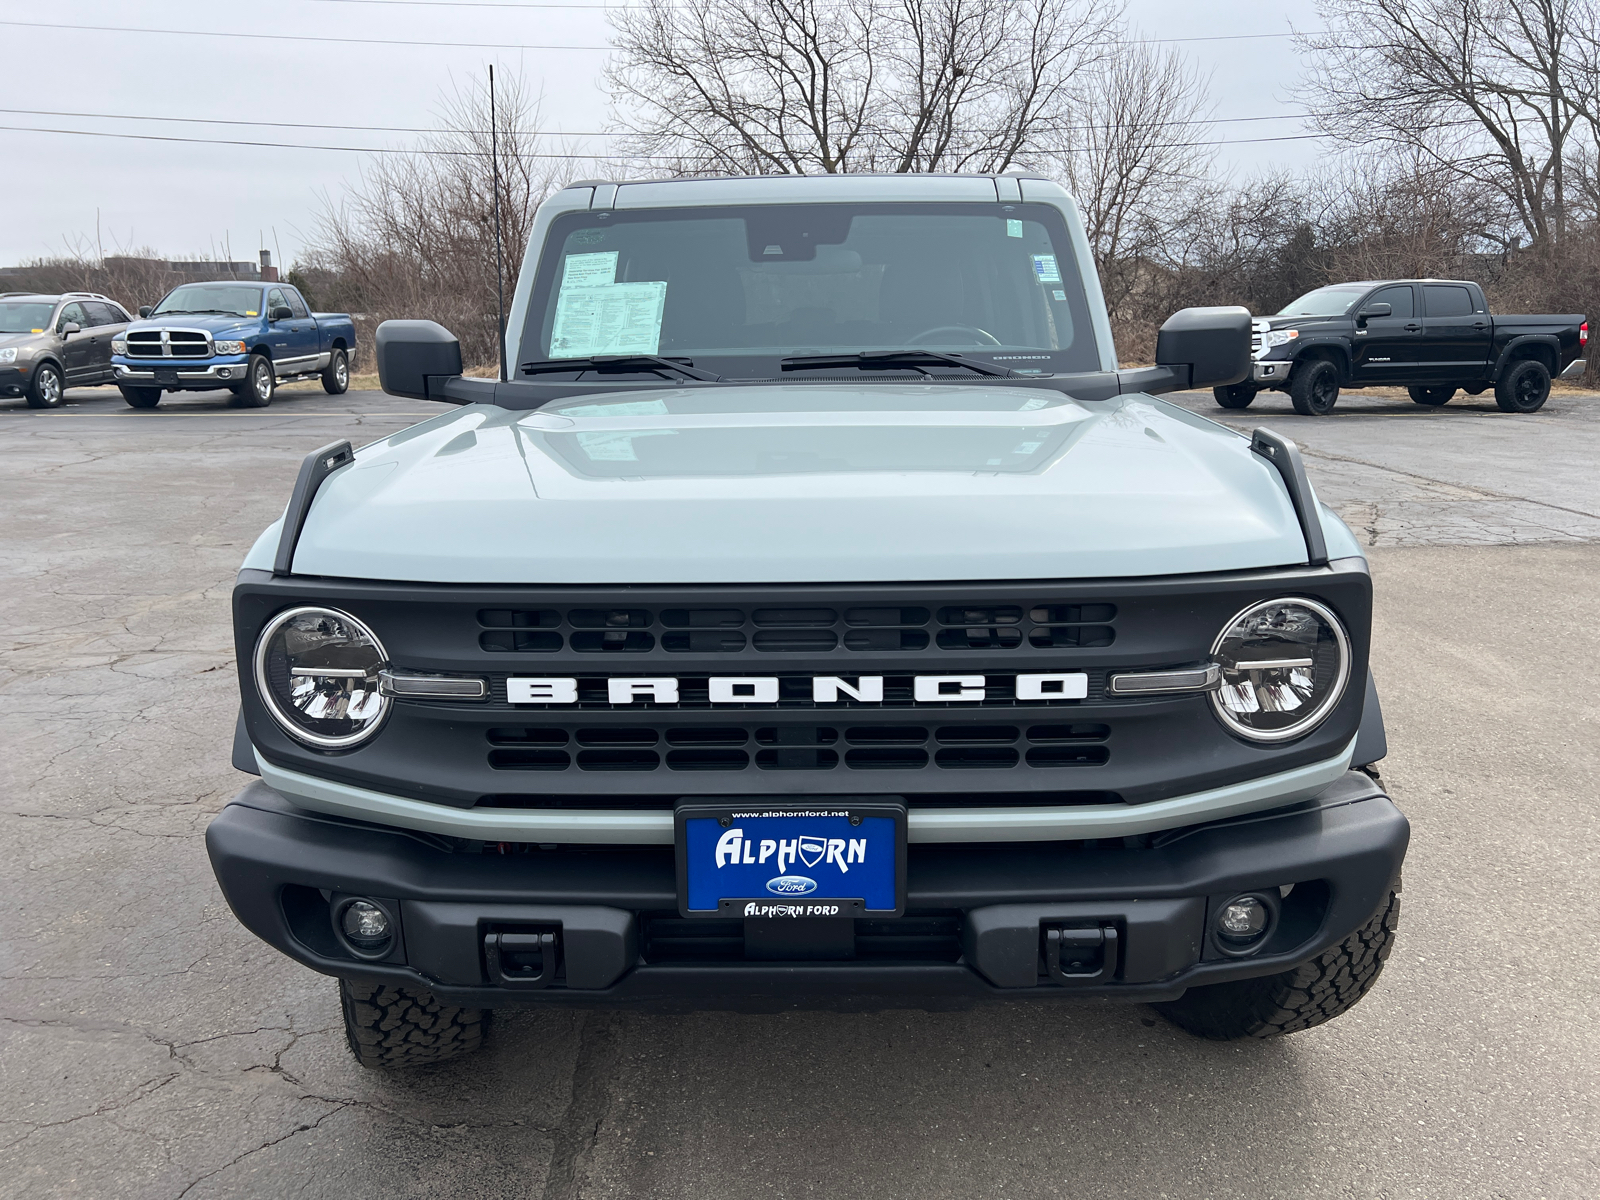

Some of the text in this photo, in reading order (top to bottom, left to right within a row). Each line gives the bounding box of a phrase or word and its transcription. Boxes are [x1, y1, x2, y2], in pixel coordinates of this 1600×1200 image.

[507, 673, 1088, 704] BRONCO
[732, 810, 849, 818] www.alphornford.net
[778, 879, 806, 892] Ford
[806, 906, 839, 916] FORD
